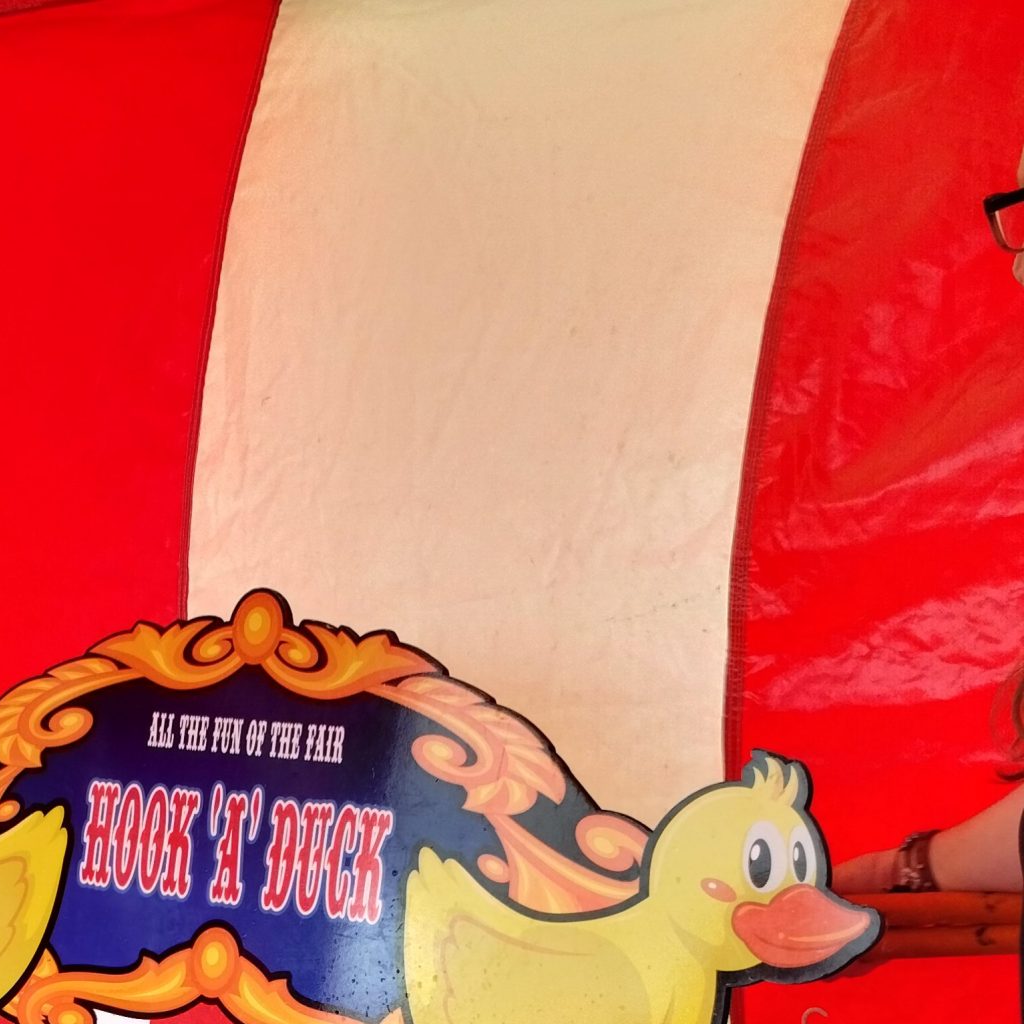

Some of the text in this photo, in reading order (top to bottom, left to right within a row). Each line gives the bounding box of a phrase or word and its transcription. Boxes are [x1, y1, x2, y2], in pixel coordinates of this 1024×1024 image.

[147, 711, 345, 764] ALL THE FUN OF THE FAIR
[80, 781, 393, 924] HOOK 'A' DUCK
